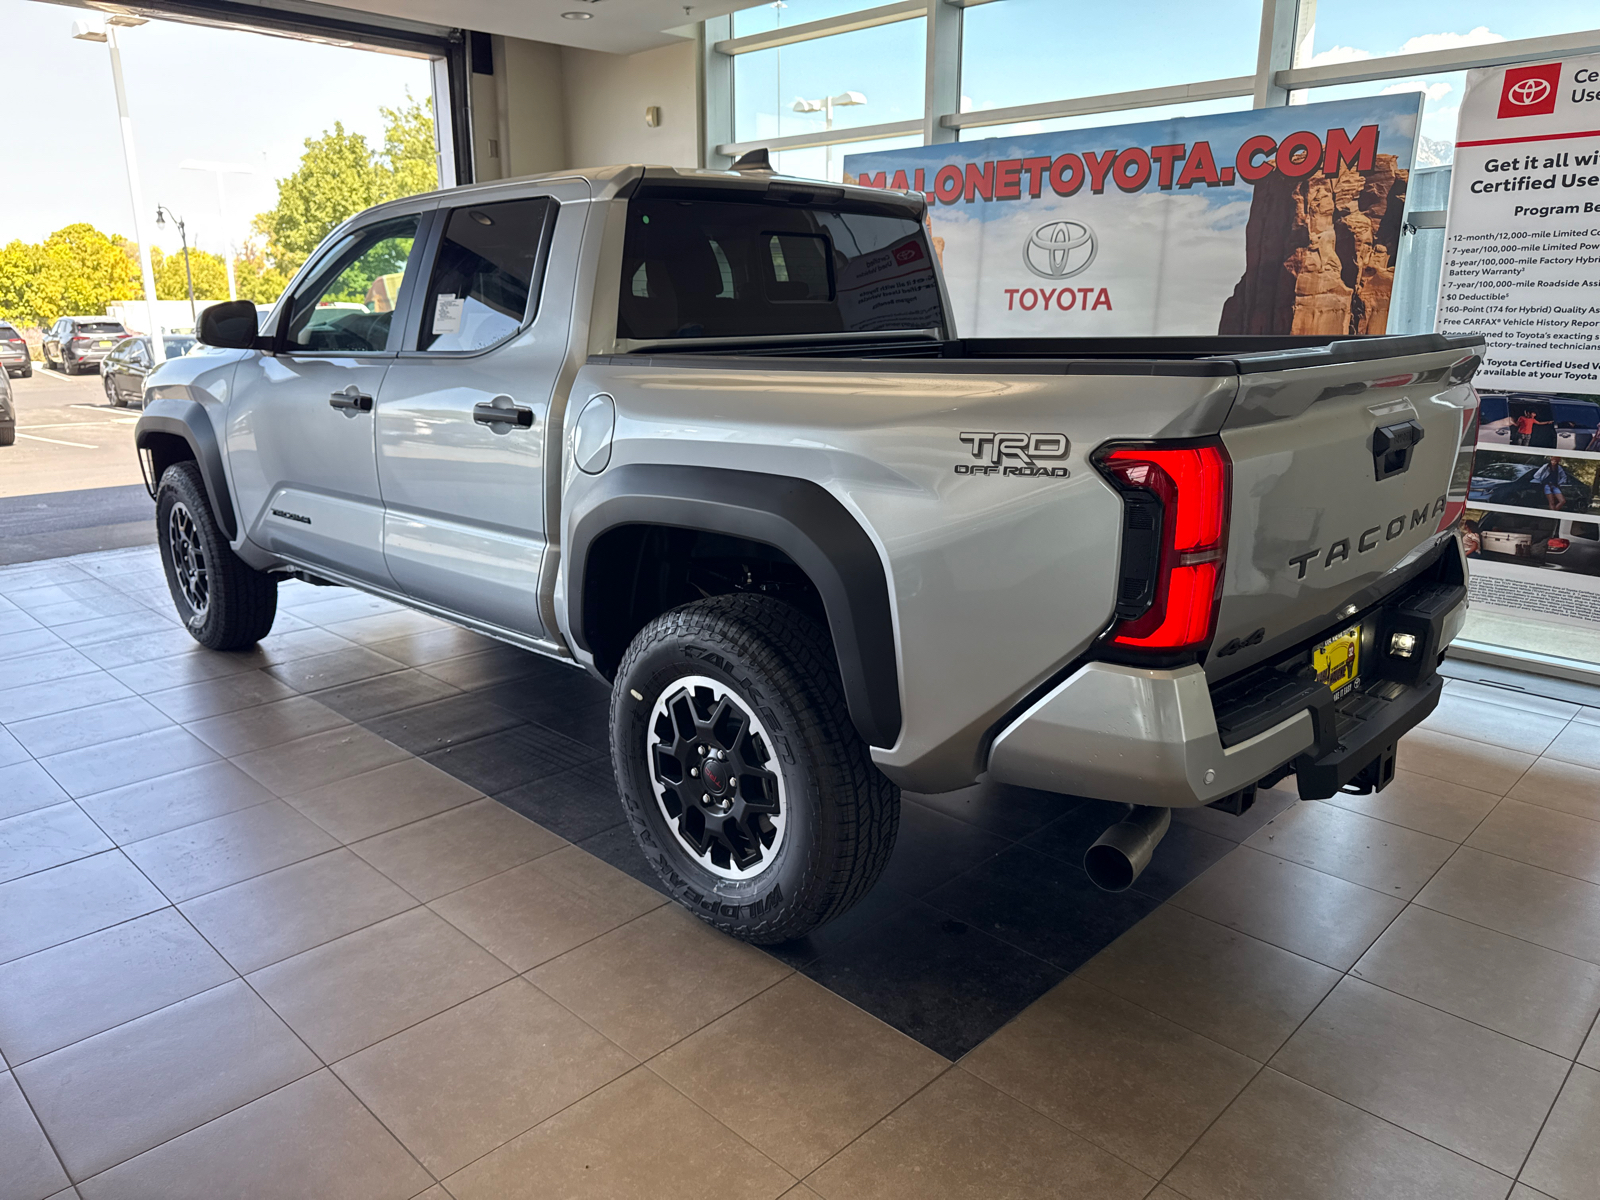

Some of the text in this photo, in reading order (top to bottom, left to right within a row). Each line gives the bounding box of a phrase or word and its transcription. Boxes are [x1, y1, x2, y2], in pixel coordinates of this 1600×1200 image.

[1484, 150, 1600, 173] Get it all wi
[1470, 174, 1556, 194] Certified
[1514, 204, 1579, 217] Program
[1453, 230, 1551, 242] 12-month/12,000-mile
[1553, 229, 1588, 238] Limited
[1452, 243, 1540, 255] 7-year/100,000-mile
[1542, 242, 1578, 251] Limited
[1450, 257, 1538, 268] 8-year/100,000-mile
[1539, 256, 1574, 265] Factory
[1449, 269, 1480, 277] Battery
[1448, 280, 1535, 290] 7-year/100,000-mile
[1537, 280, 1580, 288] Roadside
[1004, 287, 1113, 312] TOYOTA
[1446, 293, 1457, 301] $0
[1485, 306, 1503, 314] (174
[1519, 306, 1552, 315] Hybrid)
[1553, 306, 1587, 315] Quality
[1536, 319, 1570, 328] History
[1553, 333, 1593, 342] exacting
[1487, 359, 1518, 368] Toyota
[1520, 360, 1563, 369] Certified
[1564, 361, 1590, 370] Used
[1483, 369, 1527, 377] available
[1539, 372, 1563, 380] your
[1565, 372, 1598, 381] Toyota
[959, 431, 1071, 467] TRD
[954, 464, 1070, 478] OFF ROAD
[1288, 494, 1447, 580] TACOMA
